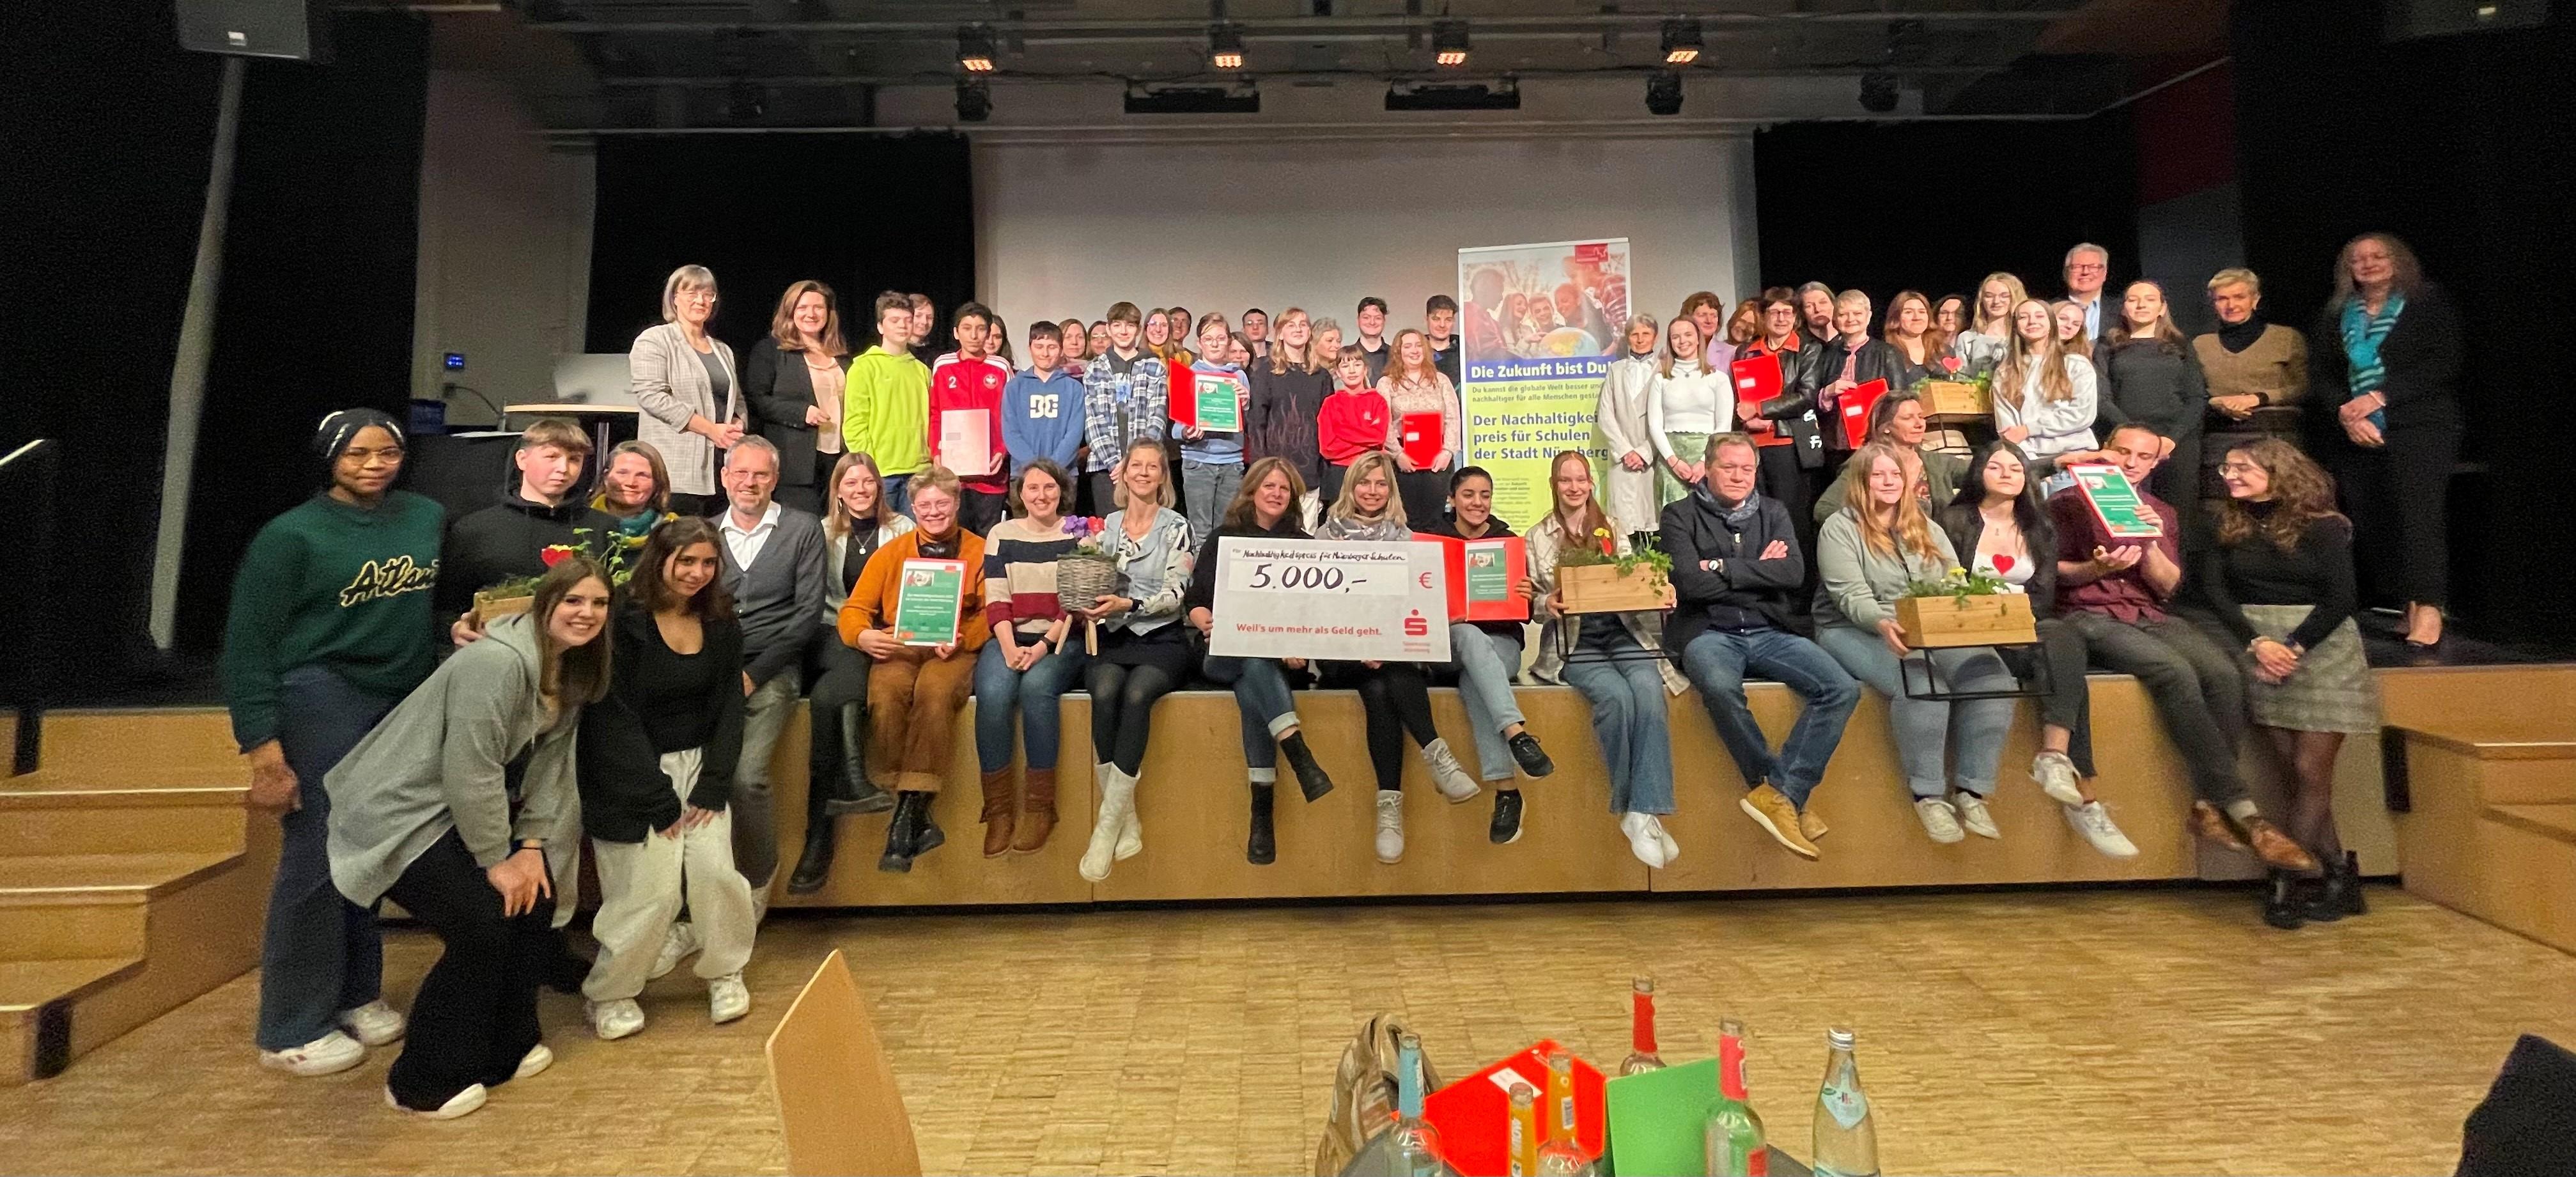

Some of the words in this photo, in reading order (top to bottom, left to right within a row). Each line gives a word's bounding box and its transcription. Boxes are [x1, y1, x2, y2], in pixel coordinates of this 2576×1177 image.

[1471, 366, 1494, 378] Die
[1498, 362, 1552, 378] Zukunft
[1556, 362, 1583, 375] bist
[948, 375, 957, 389] 2
[1473, 415, 1497, 426] Der
[1501, 411, 1598, 426] Nachhaltigkei
[1473, 430, 1507, 446] preis
[1511, 430, 1531, 442] für
[1535, 429, 1590, 442] Schulen
[1474, 448, 1497, 459] der
[1501, 447, 1539, 459] Stadt
[1418, 572, 1433, 589] €
[1236, 623, 1266, 633] Weil's
[1286, 625, 1312, 634] mehr
[1315, 626, 1329, 634] als
[1331, 626, 1354, 635] Geld
[1356, 627, 1383, 637] geht.
